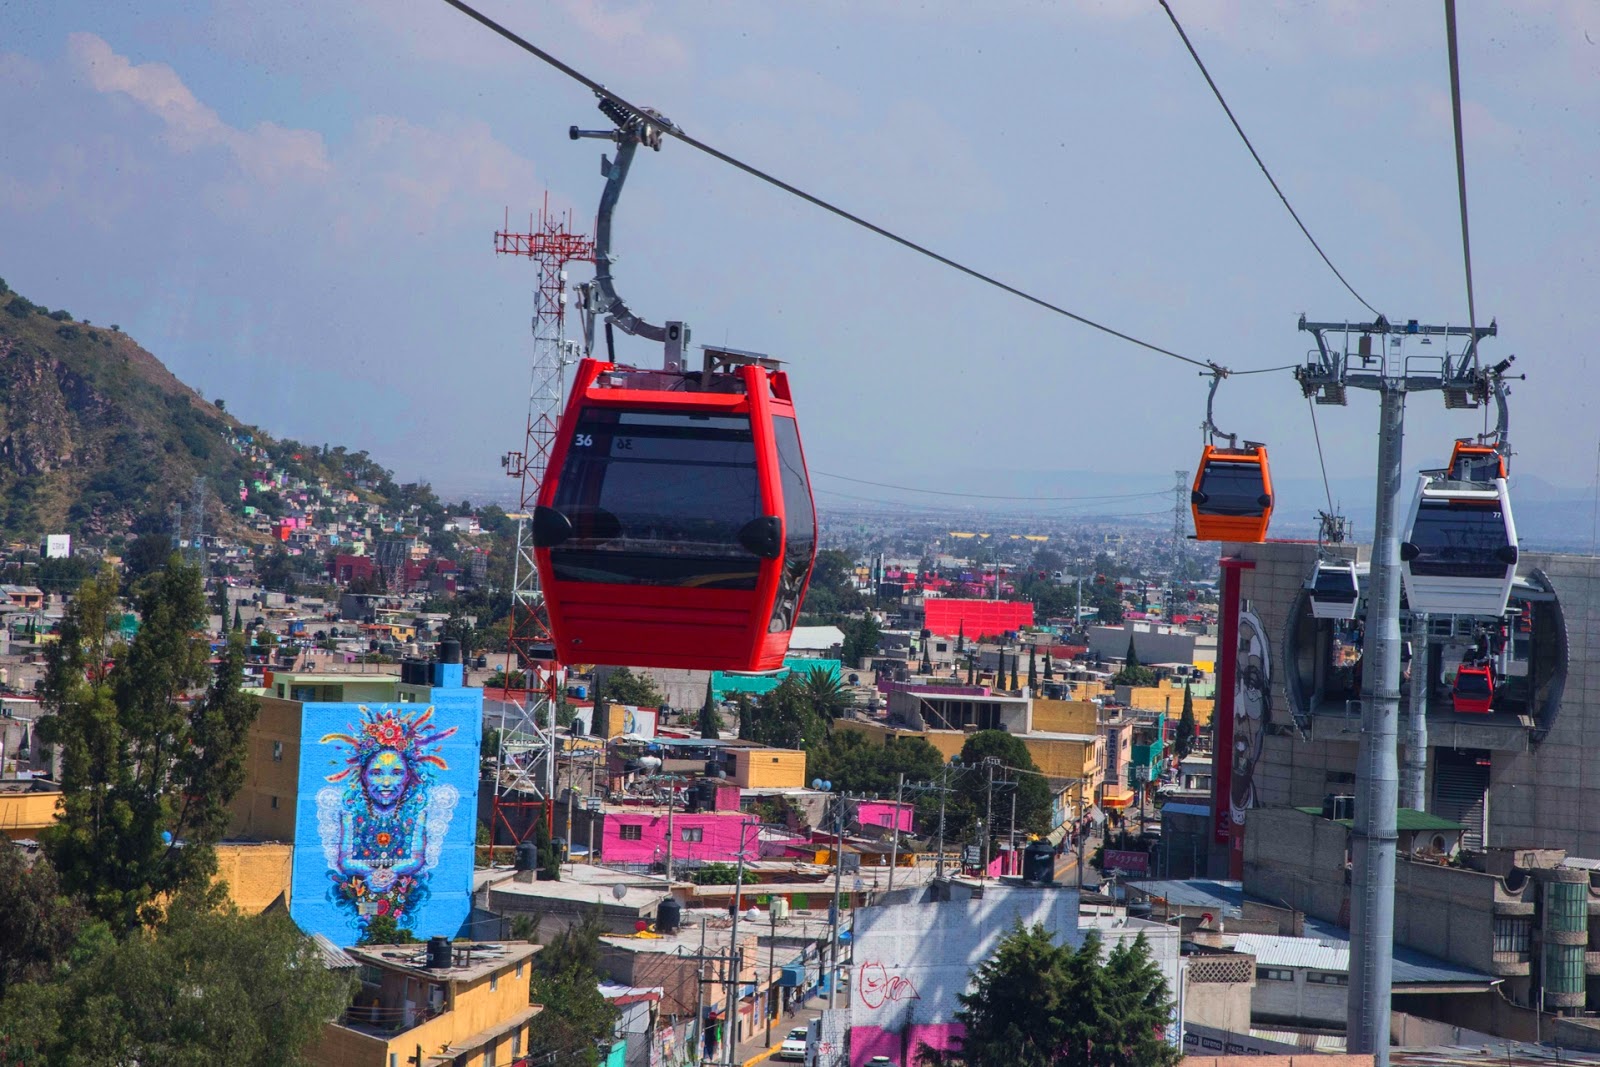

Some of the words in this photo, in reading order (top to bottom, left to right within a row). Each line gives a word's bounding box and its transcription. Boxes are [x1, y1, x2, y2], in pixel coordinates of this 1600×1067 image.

[575, 434, 592, 446] 36
[1108, 729, 1116, 769] FARMACIA
[1203, 1039, 1221, 1049] arena
